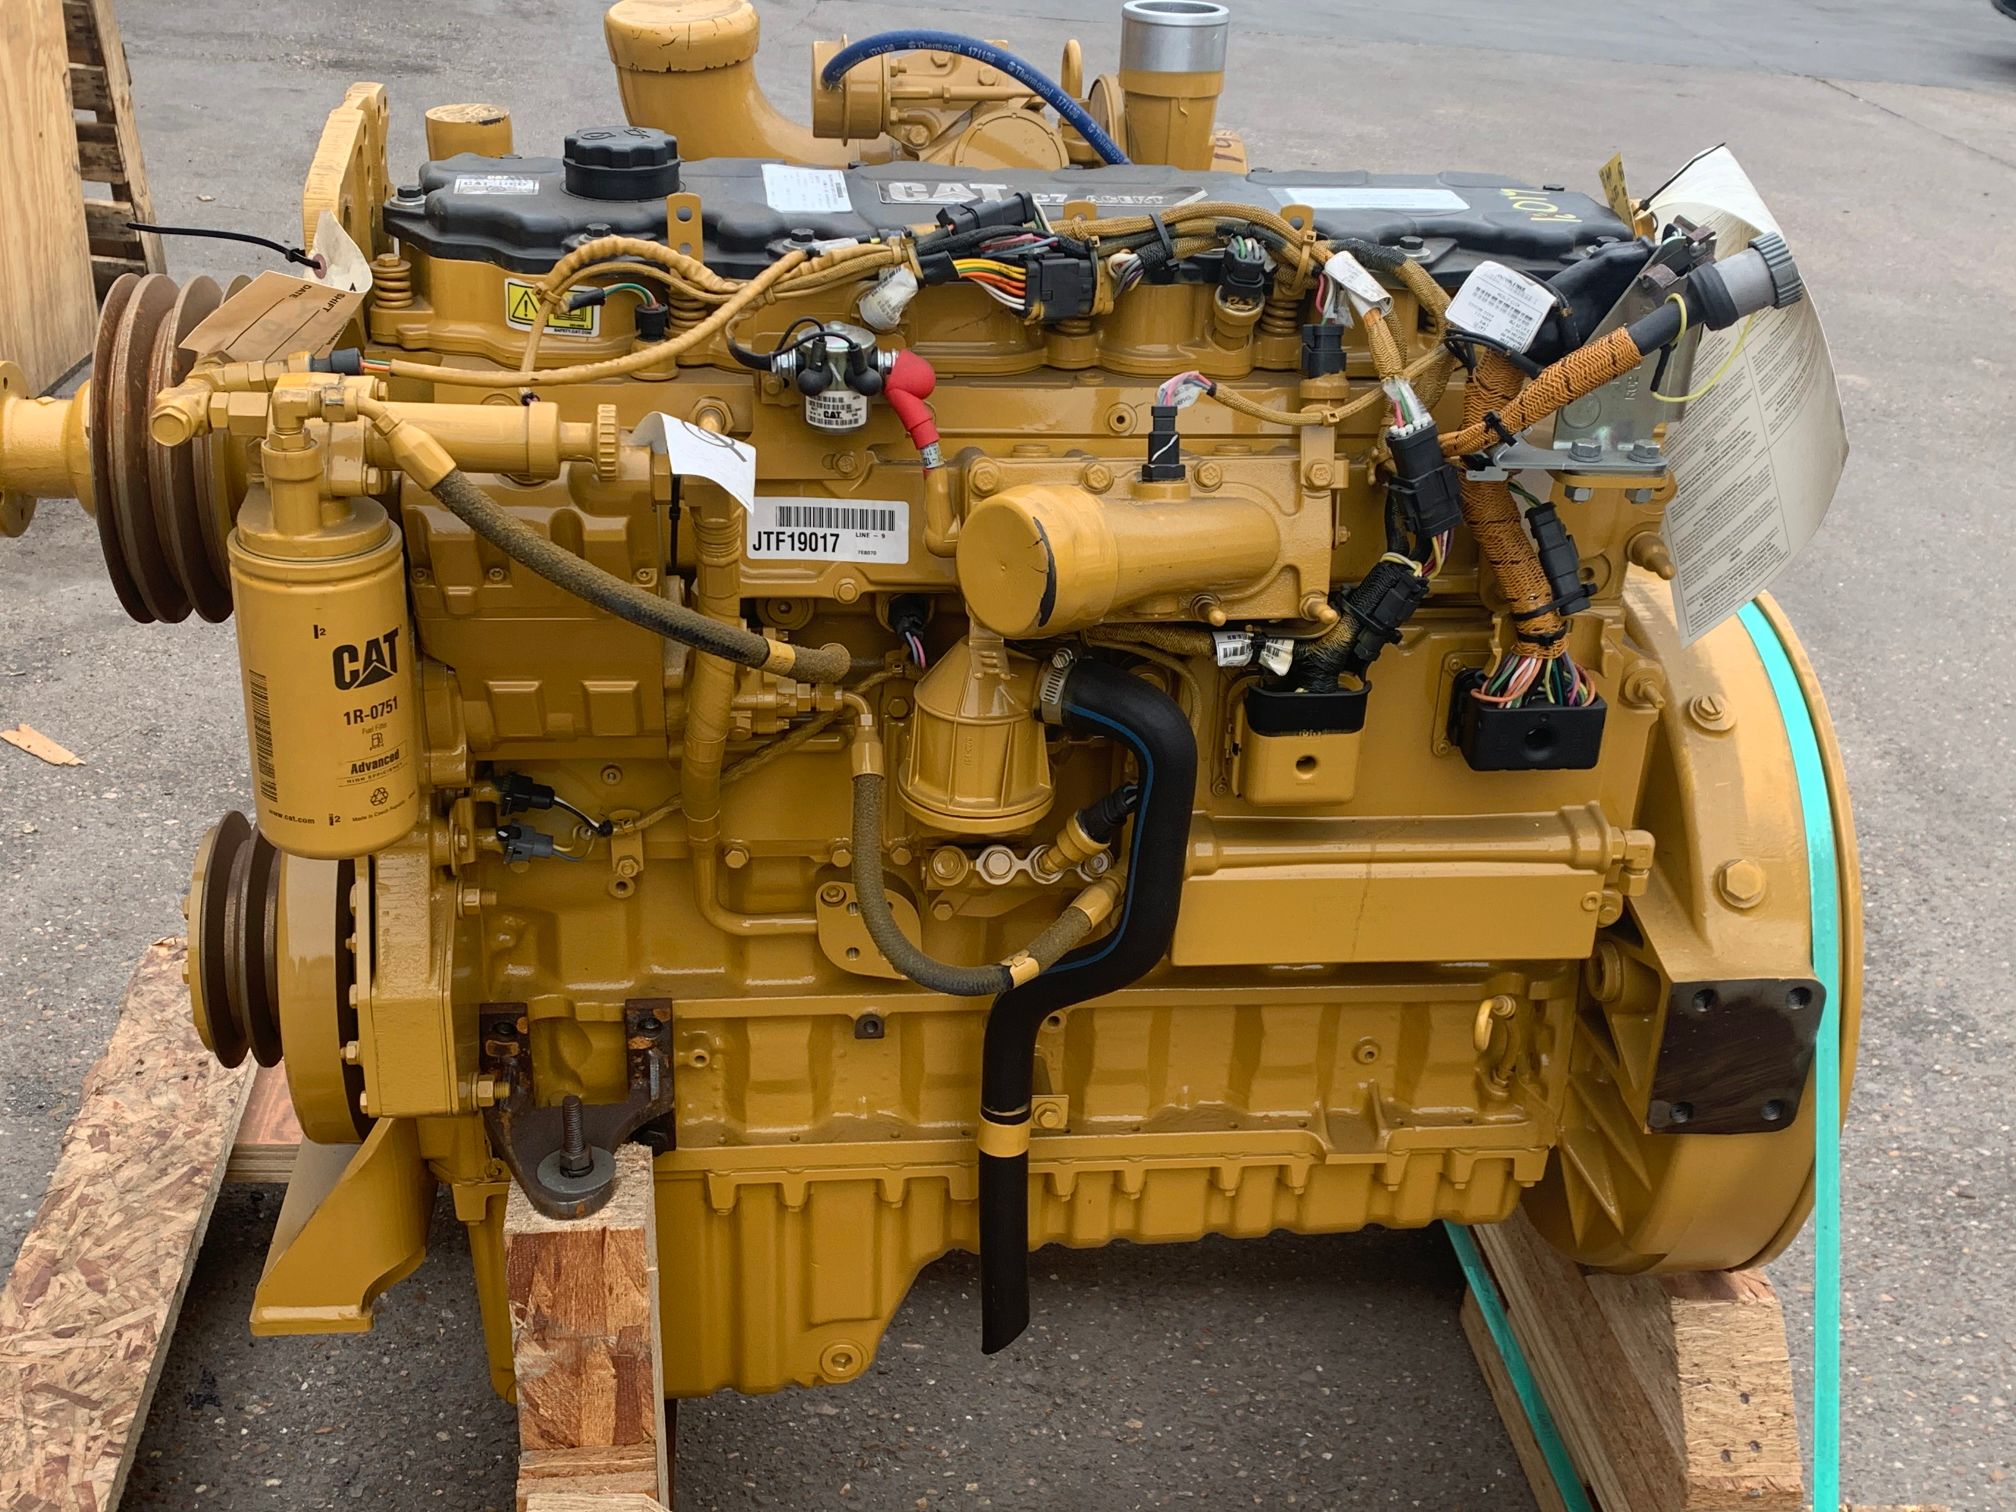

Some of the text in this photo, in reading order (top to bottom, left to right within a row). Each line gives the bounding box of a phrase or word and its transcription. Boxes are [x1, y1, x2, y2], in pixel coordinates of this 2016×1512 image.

[1016, 65, 1055, 97] Thermopol
[888, 182, 1008, 203] CAT
[289, 284, 312, 299] DATE
[322, 293, 346, 313] SHIFT
[752, 531, 840, 553] JTF19017
[332, 627, 399, 691] CAT
[343, 696, 398, 726] 1R-0751
[350, 748, 400, 775] Advanced
